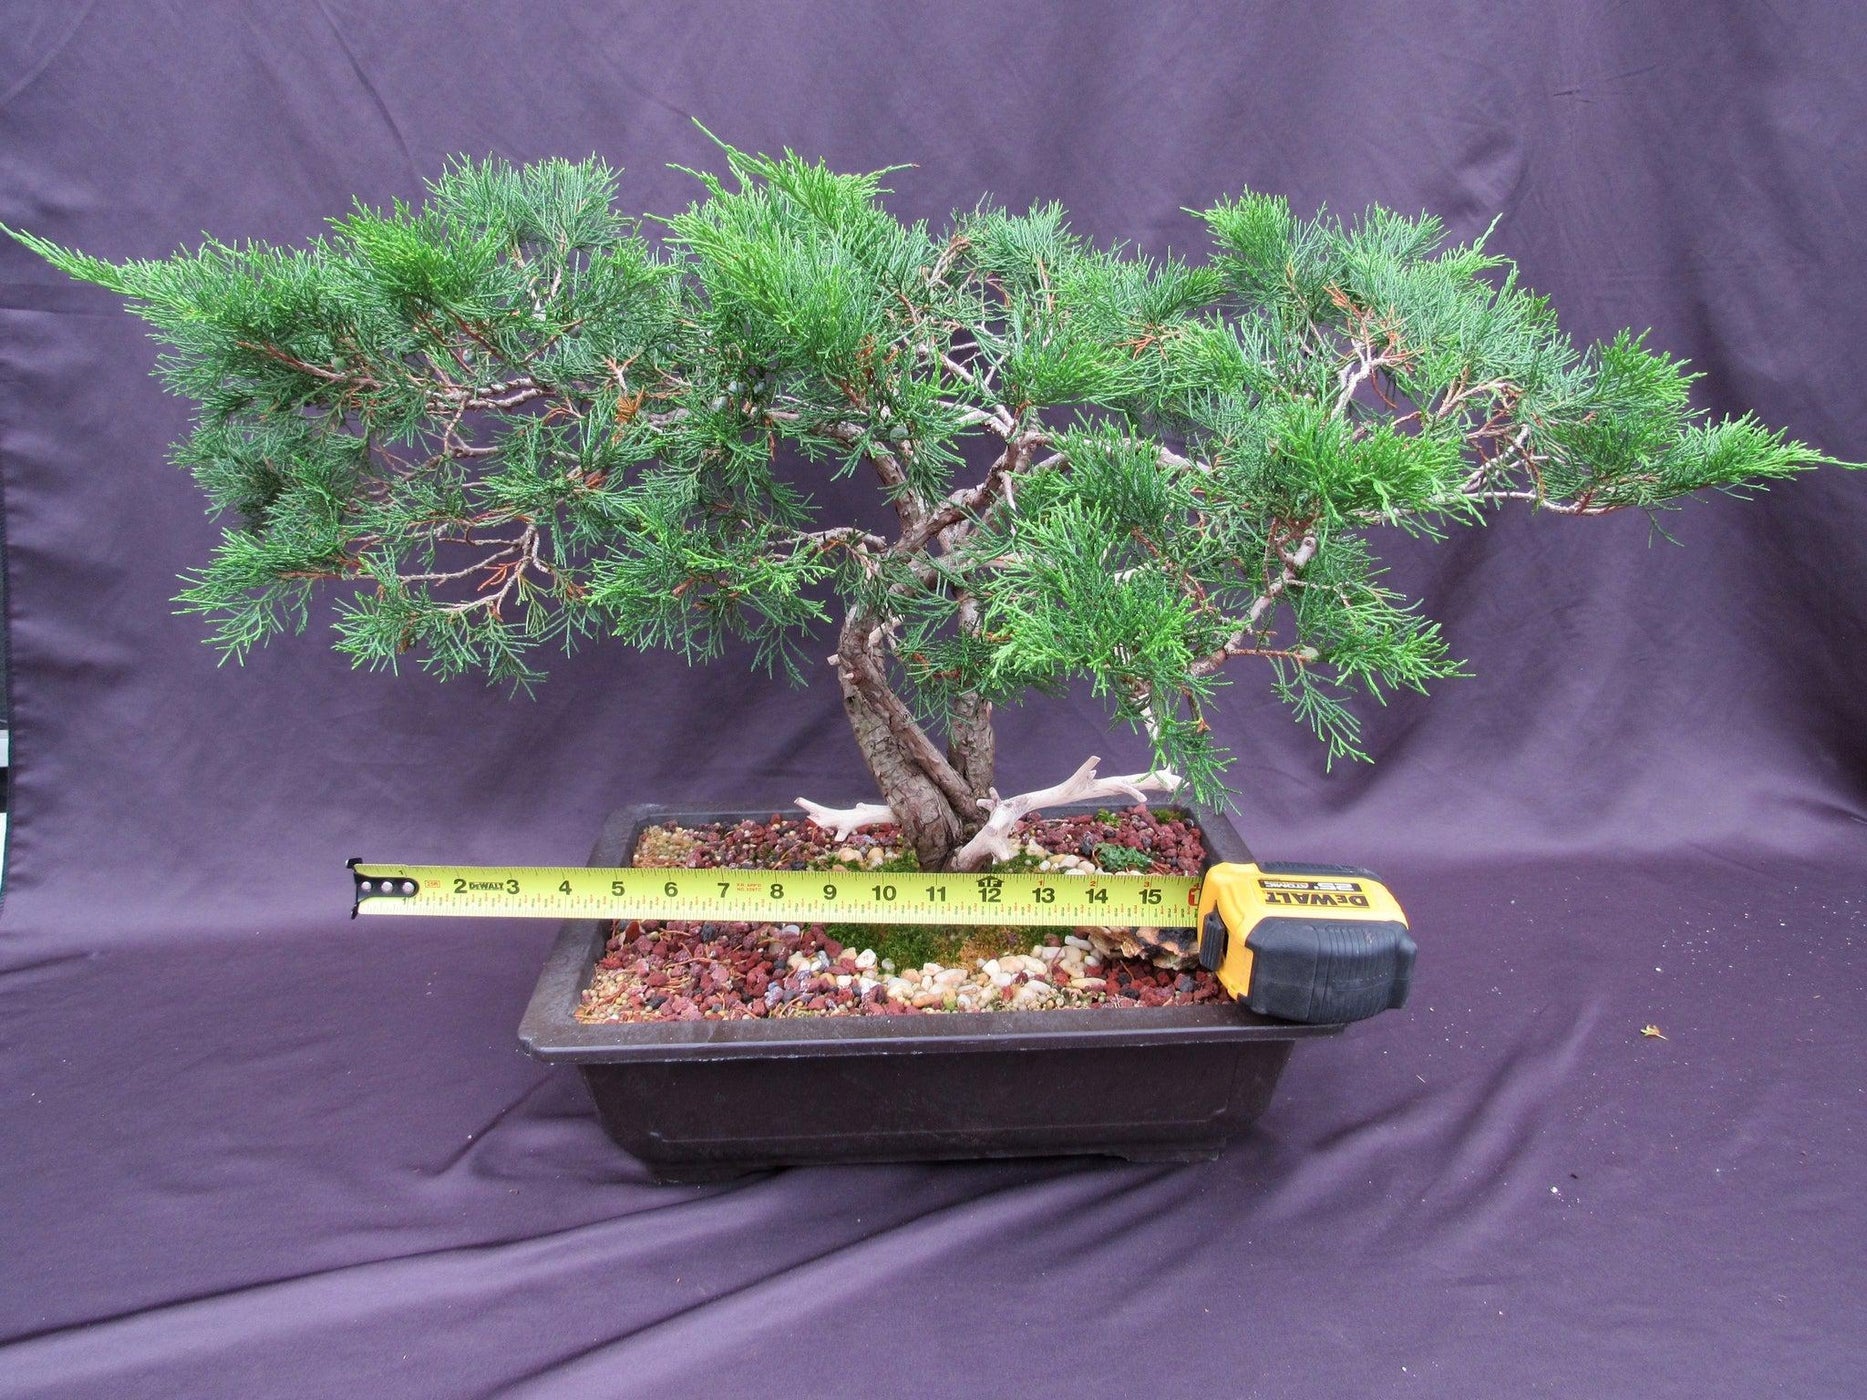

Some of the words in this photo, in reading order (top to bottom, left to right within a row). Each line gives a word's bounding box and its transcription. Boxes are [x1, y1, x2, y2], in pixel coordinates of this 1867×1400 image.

[453, 878, 468, 894] 2
[506, 879, 520, 895] 3
[558, 880, 573, 896] 4
[611, 881, 626, 897] 5
[664, 881, 679, 898] 6
[717, 882, 730, 898] 7
[769, 883, 785, 899] 8
[823, 884, 837, 900] 9
[871, 885, 897, 901] 10
[925, 886, 946, 902] 11
[978, 887, 1001, 903] 12
[1032, 887, 1055, 904] 13
[1085, 888, 1108, 904] 14
[1138, 889, 1162, 905] 15
